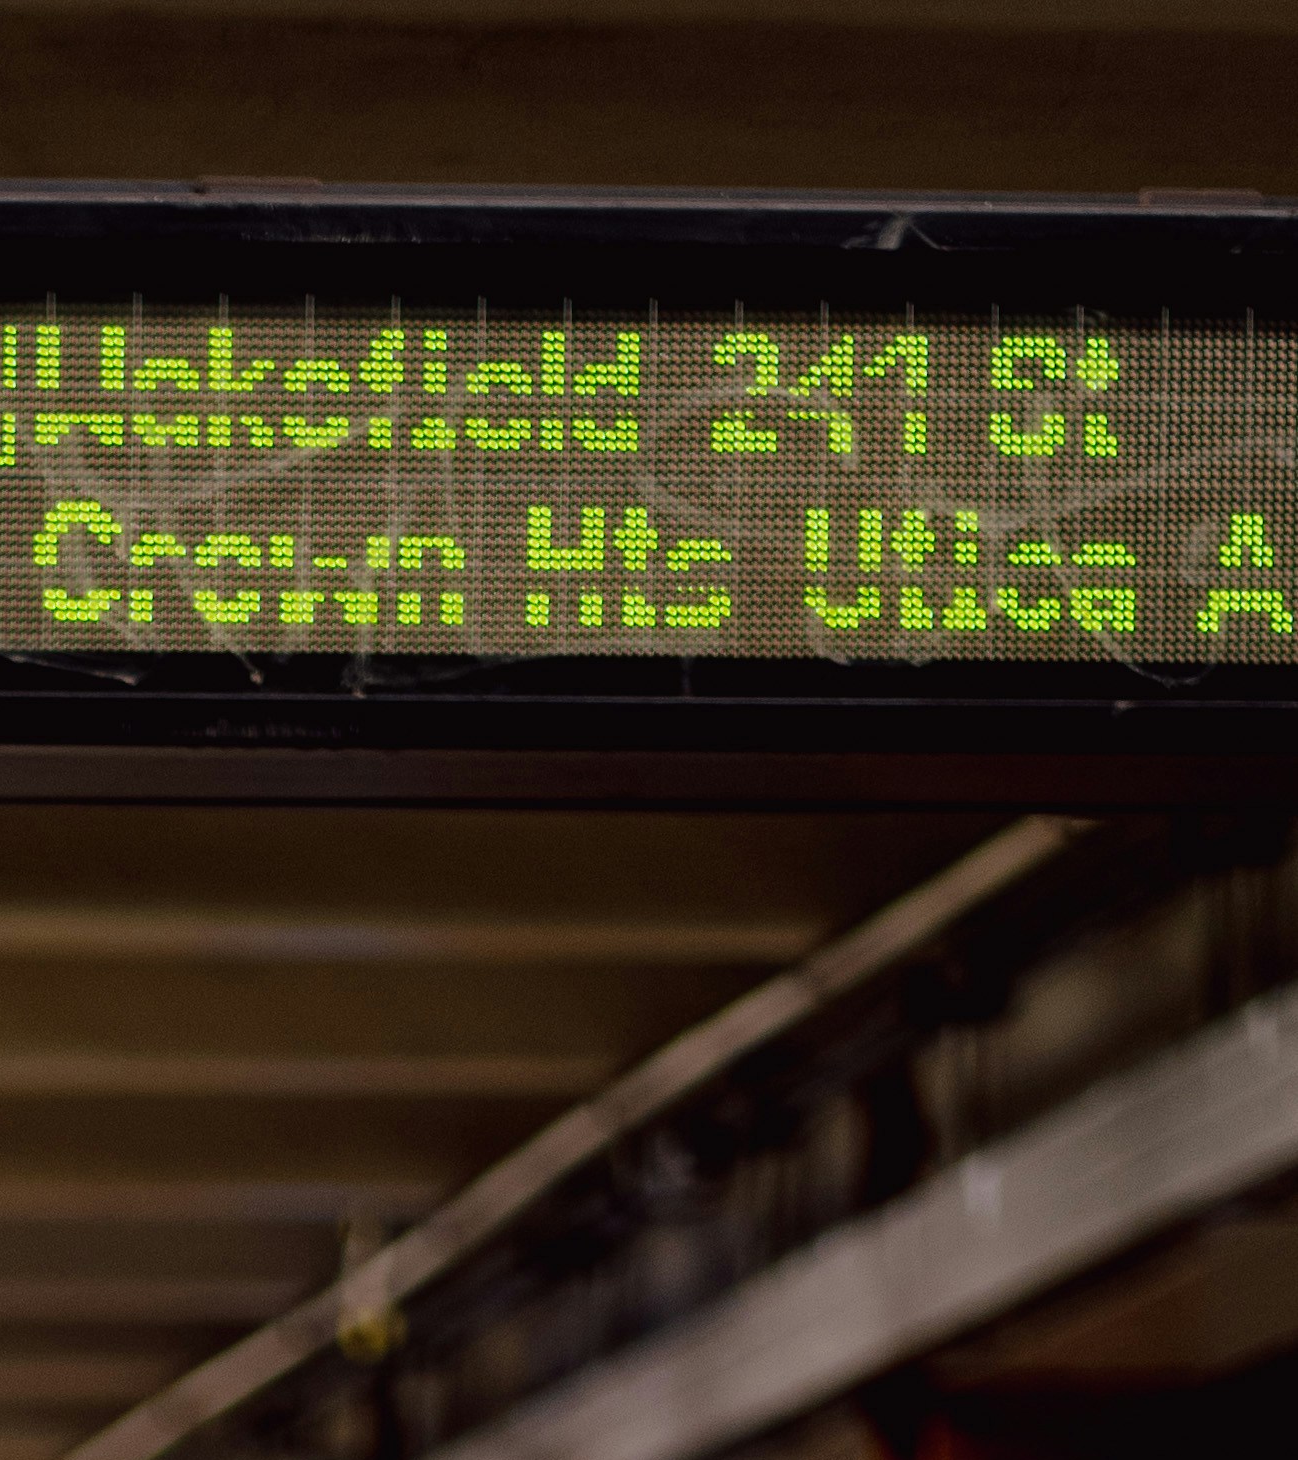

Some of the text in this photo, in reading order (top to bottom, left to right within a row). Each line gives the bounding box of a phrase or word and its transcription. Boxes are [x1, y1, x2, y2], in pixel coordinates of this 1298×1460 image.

[35, 324, 639, 452] Wakefield
[710, 332, 928, 455] 241
[990, 336, 1119, 457] St
[33, 500, 465, 625] Crown
[524, 506, 732, 629] Hts
[803, 508, 1136, 632] Utica
